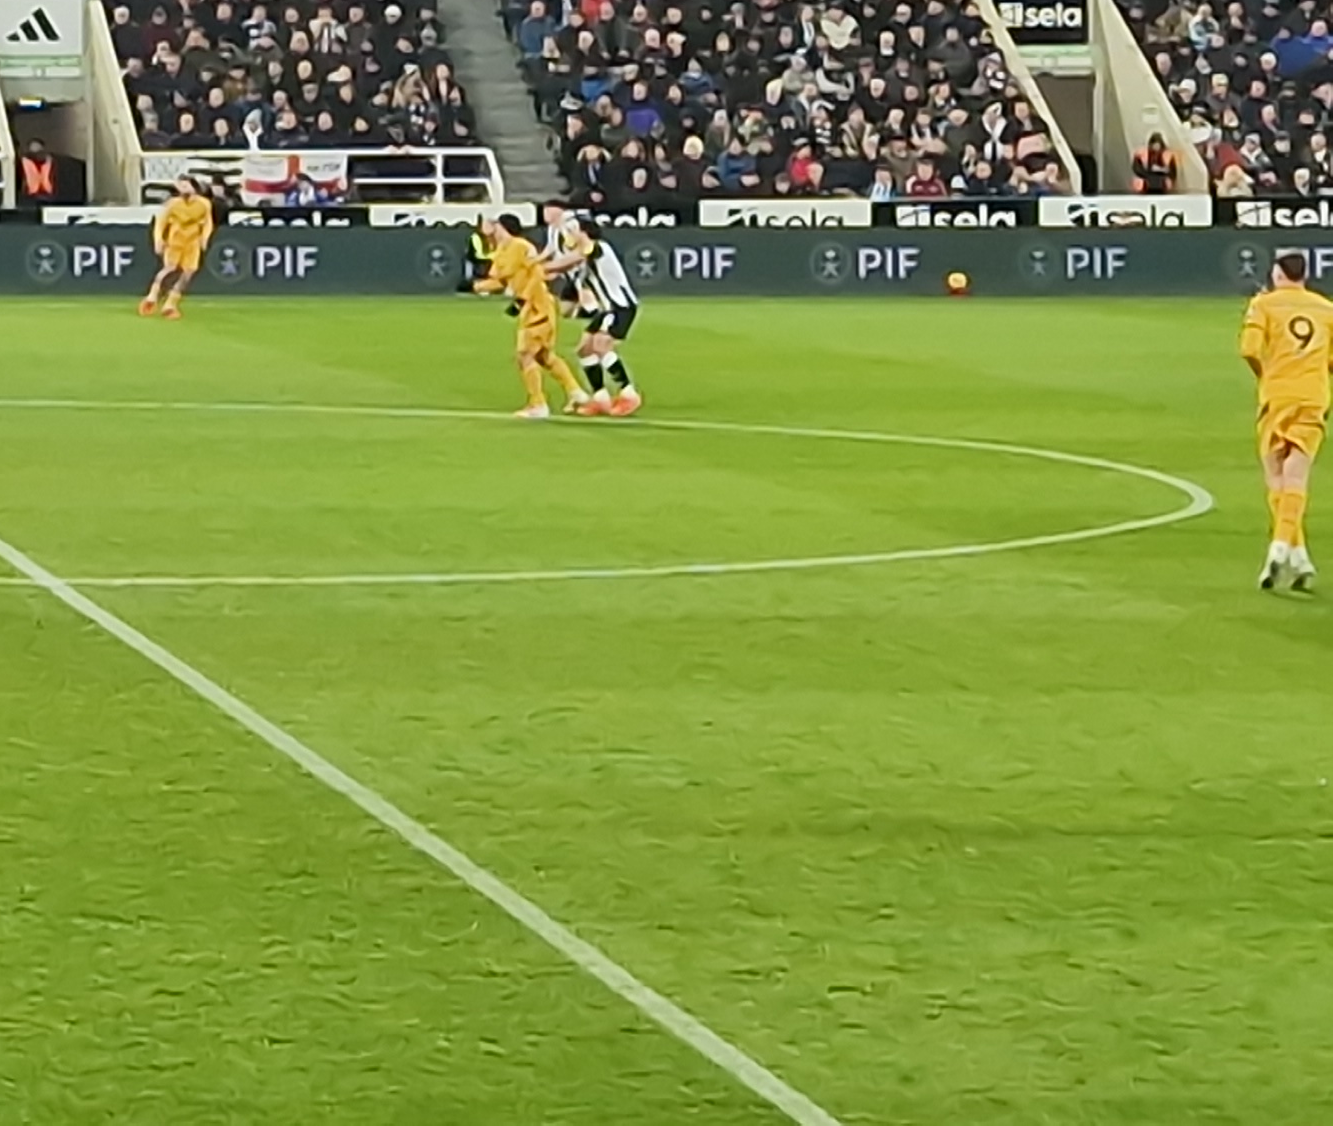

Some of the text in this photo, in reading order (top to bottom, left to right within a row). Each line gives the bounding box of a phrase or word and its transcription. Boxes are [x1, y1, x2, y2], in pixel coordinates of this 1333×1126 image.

[1024, 2, 1082, 27] sela
[1274, 200, 1333, 227] sel
[73, 244, 134, 276] PIF
[256, 246, 318, 278] PIF
[673, 247, 736, 279] PIF
[858, 247, 920, 279] PIF
[1066, 247, 1127, 279] PIF
[1288, 315, 1314, 352] 9
